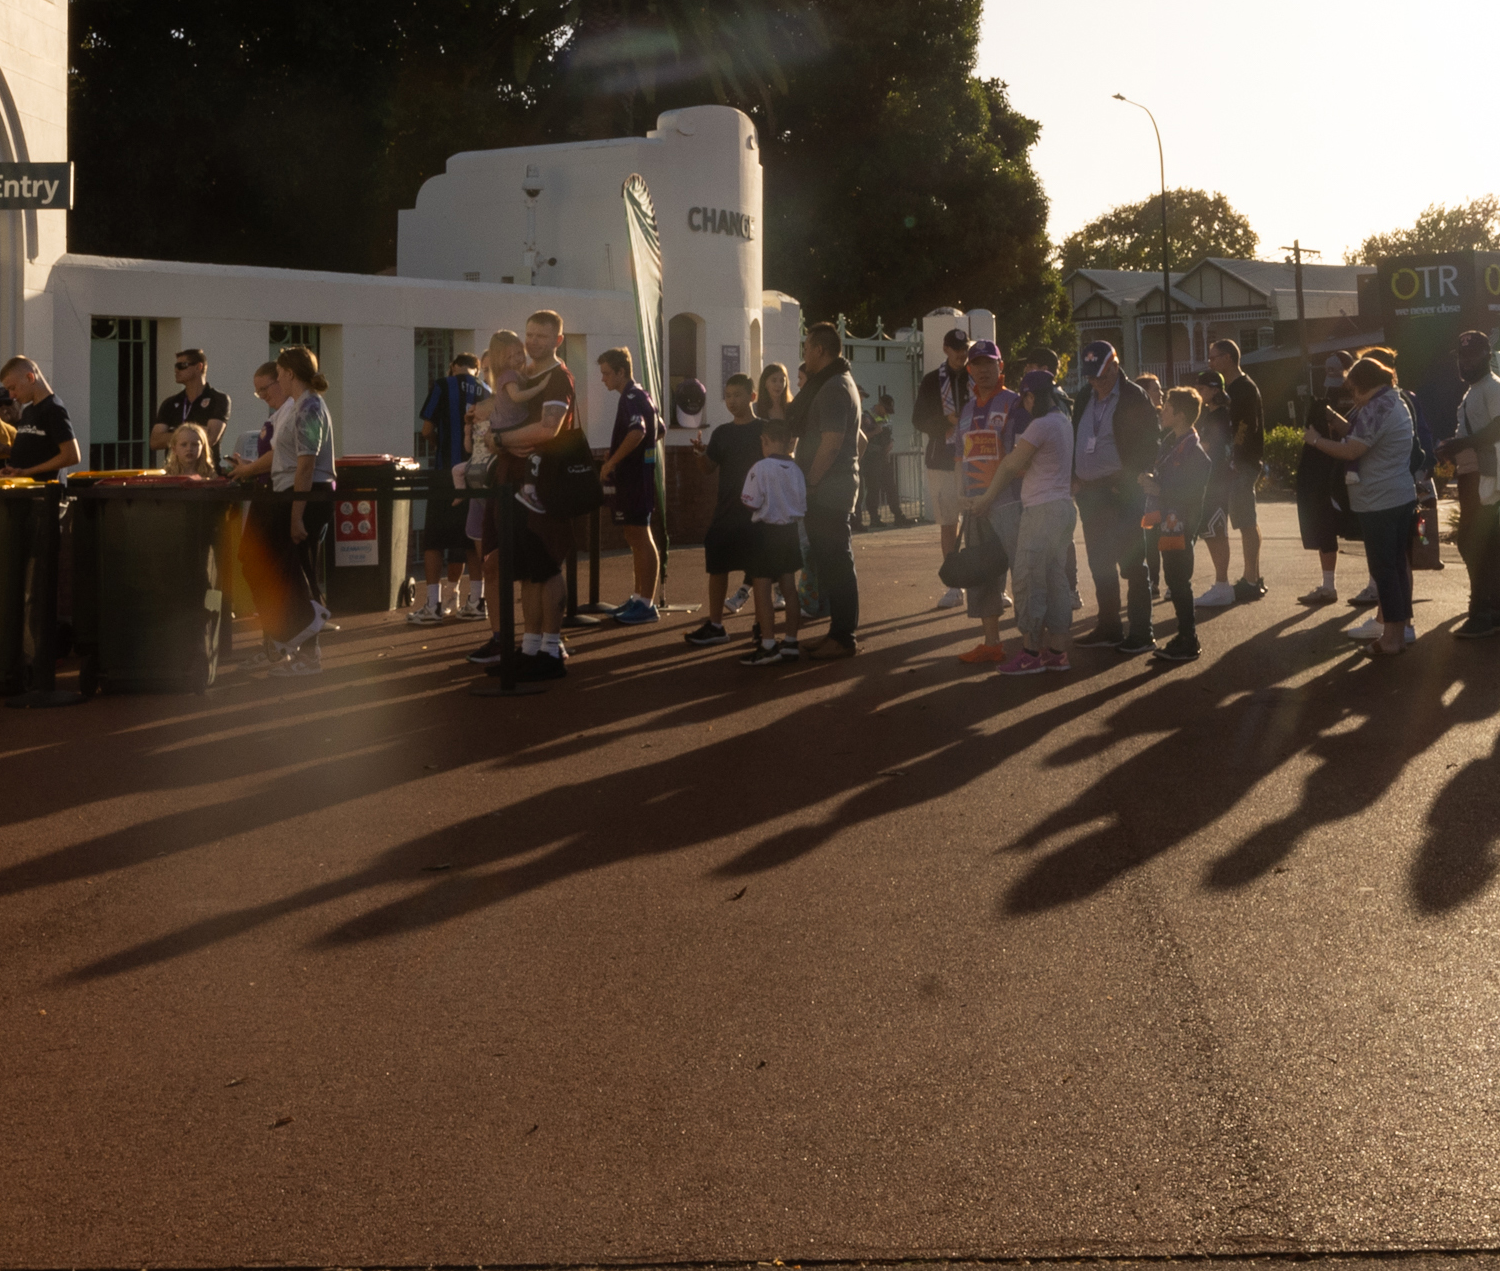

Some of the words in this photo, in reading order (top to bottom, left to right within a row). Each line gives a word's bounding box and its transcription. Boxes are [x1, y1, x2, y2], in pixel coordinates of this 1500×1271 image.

[688, 206, 756, 240] CHANGE
[1391, 264, 1460, 301] OTR
[1395, 307, 1409, 316] we
[1410, 304, 1435, 314] never
[1436, 303, 1461, 313] close
